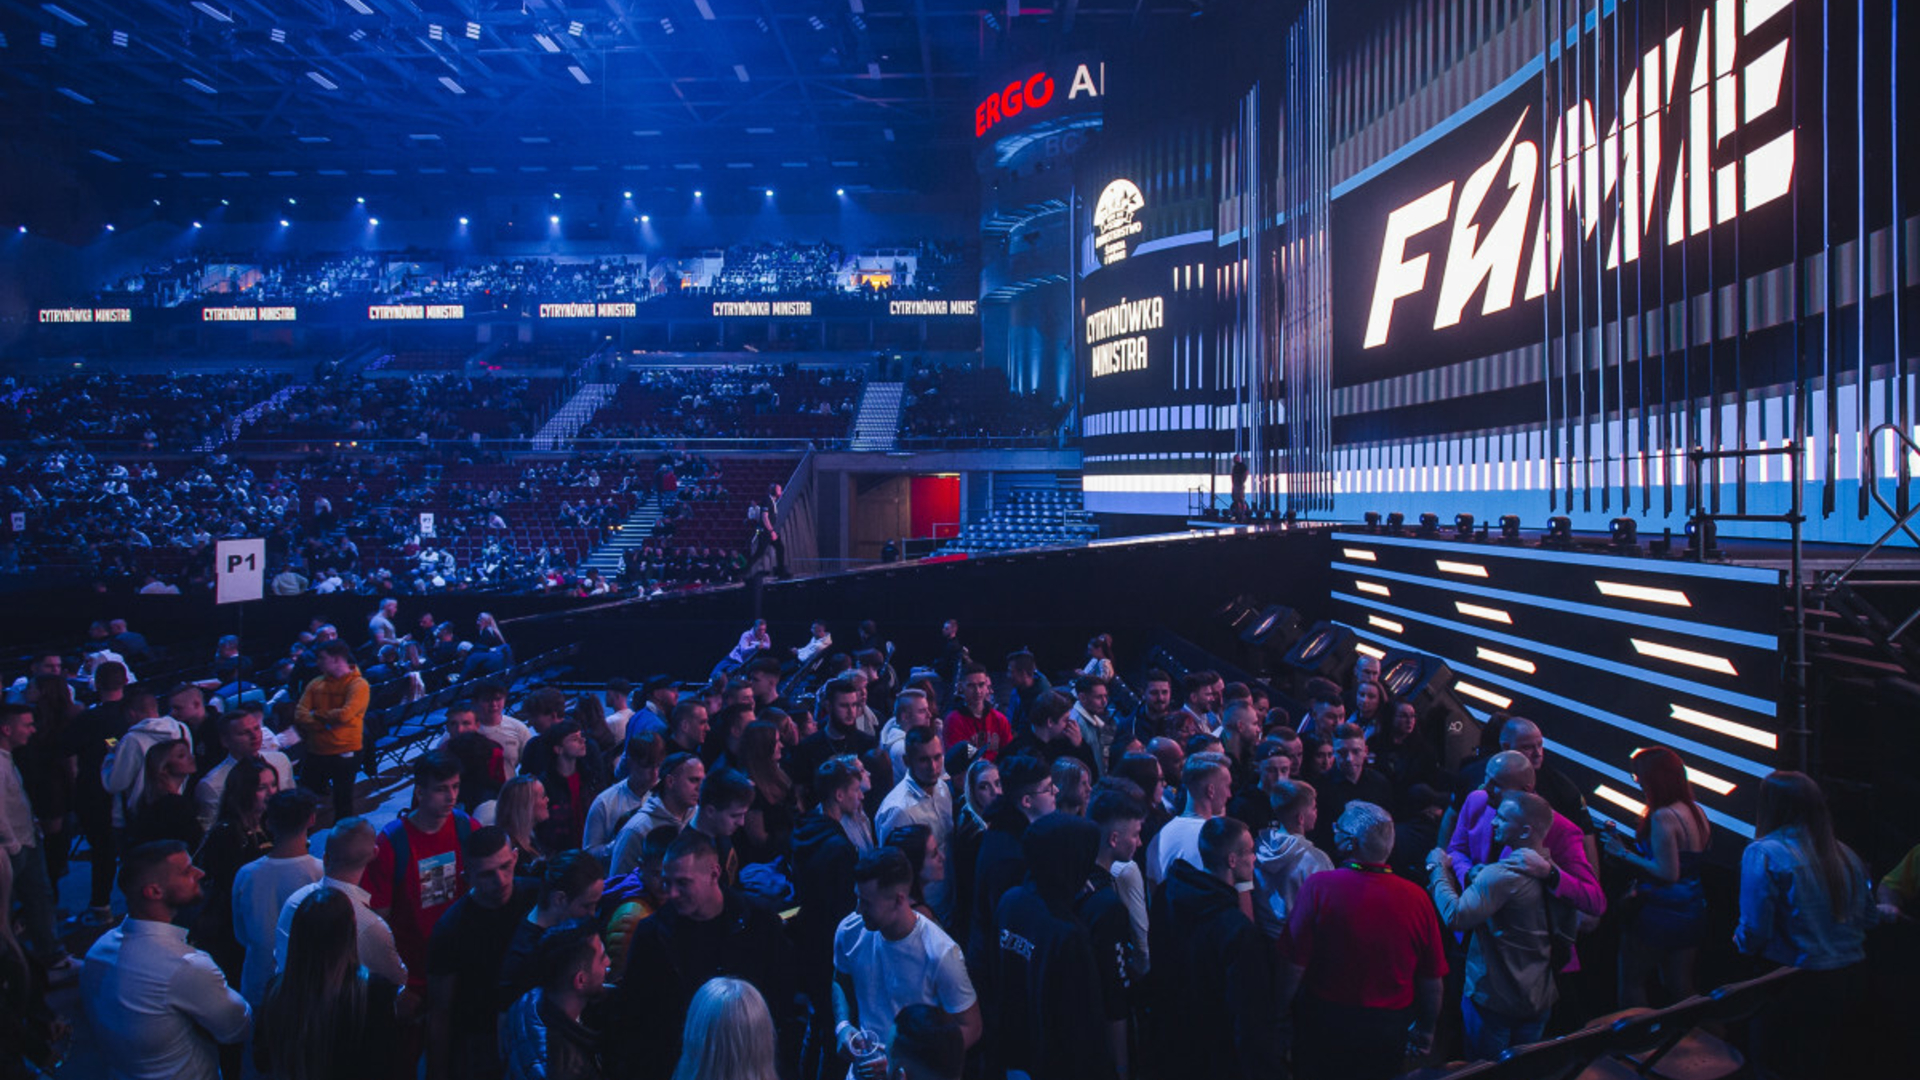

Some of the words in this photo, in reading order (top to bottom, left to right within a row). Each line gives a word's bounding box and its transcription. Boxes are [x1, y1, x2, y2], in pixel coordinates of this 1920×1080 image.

[976, 71, 1055, 138] ERGO
[1363, 0, 1796, 349] FAME
[540, 302, 595, 317] CYTRYNÓWKA
[598, 303, 636, 317] MINISTRA
[713, 300, 770, 316] CYTRYNÓWKA
[772, 302, 812, 316] MINISTRA
[889, 299, 948, 315] CYTRYNÓWKA
[1086, 296, 1163, 344] CYTRYNÓWKA
[1092, 336, 1148, 378] MINISTRA
[227, 553, 255, 573] P1
